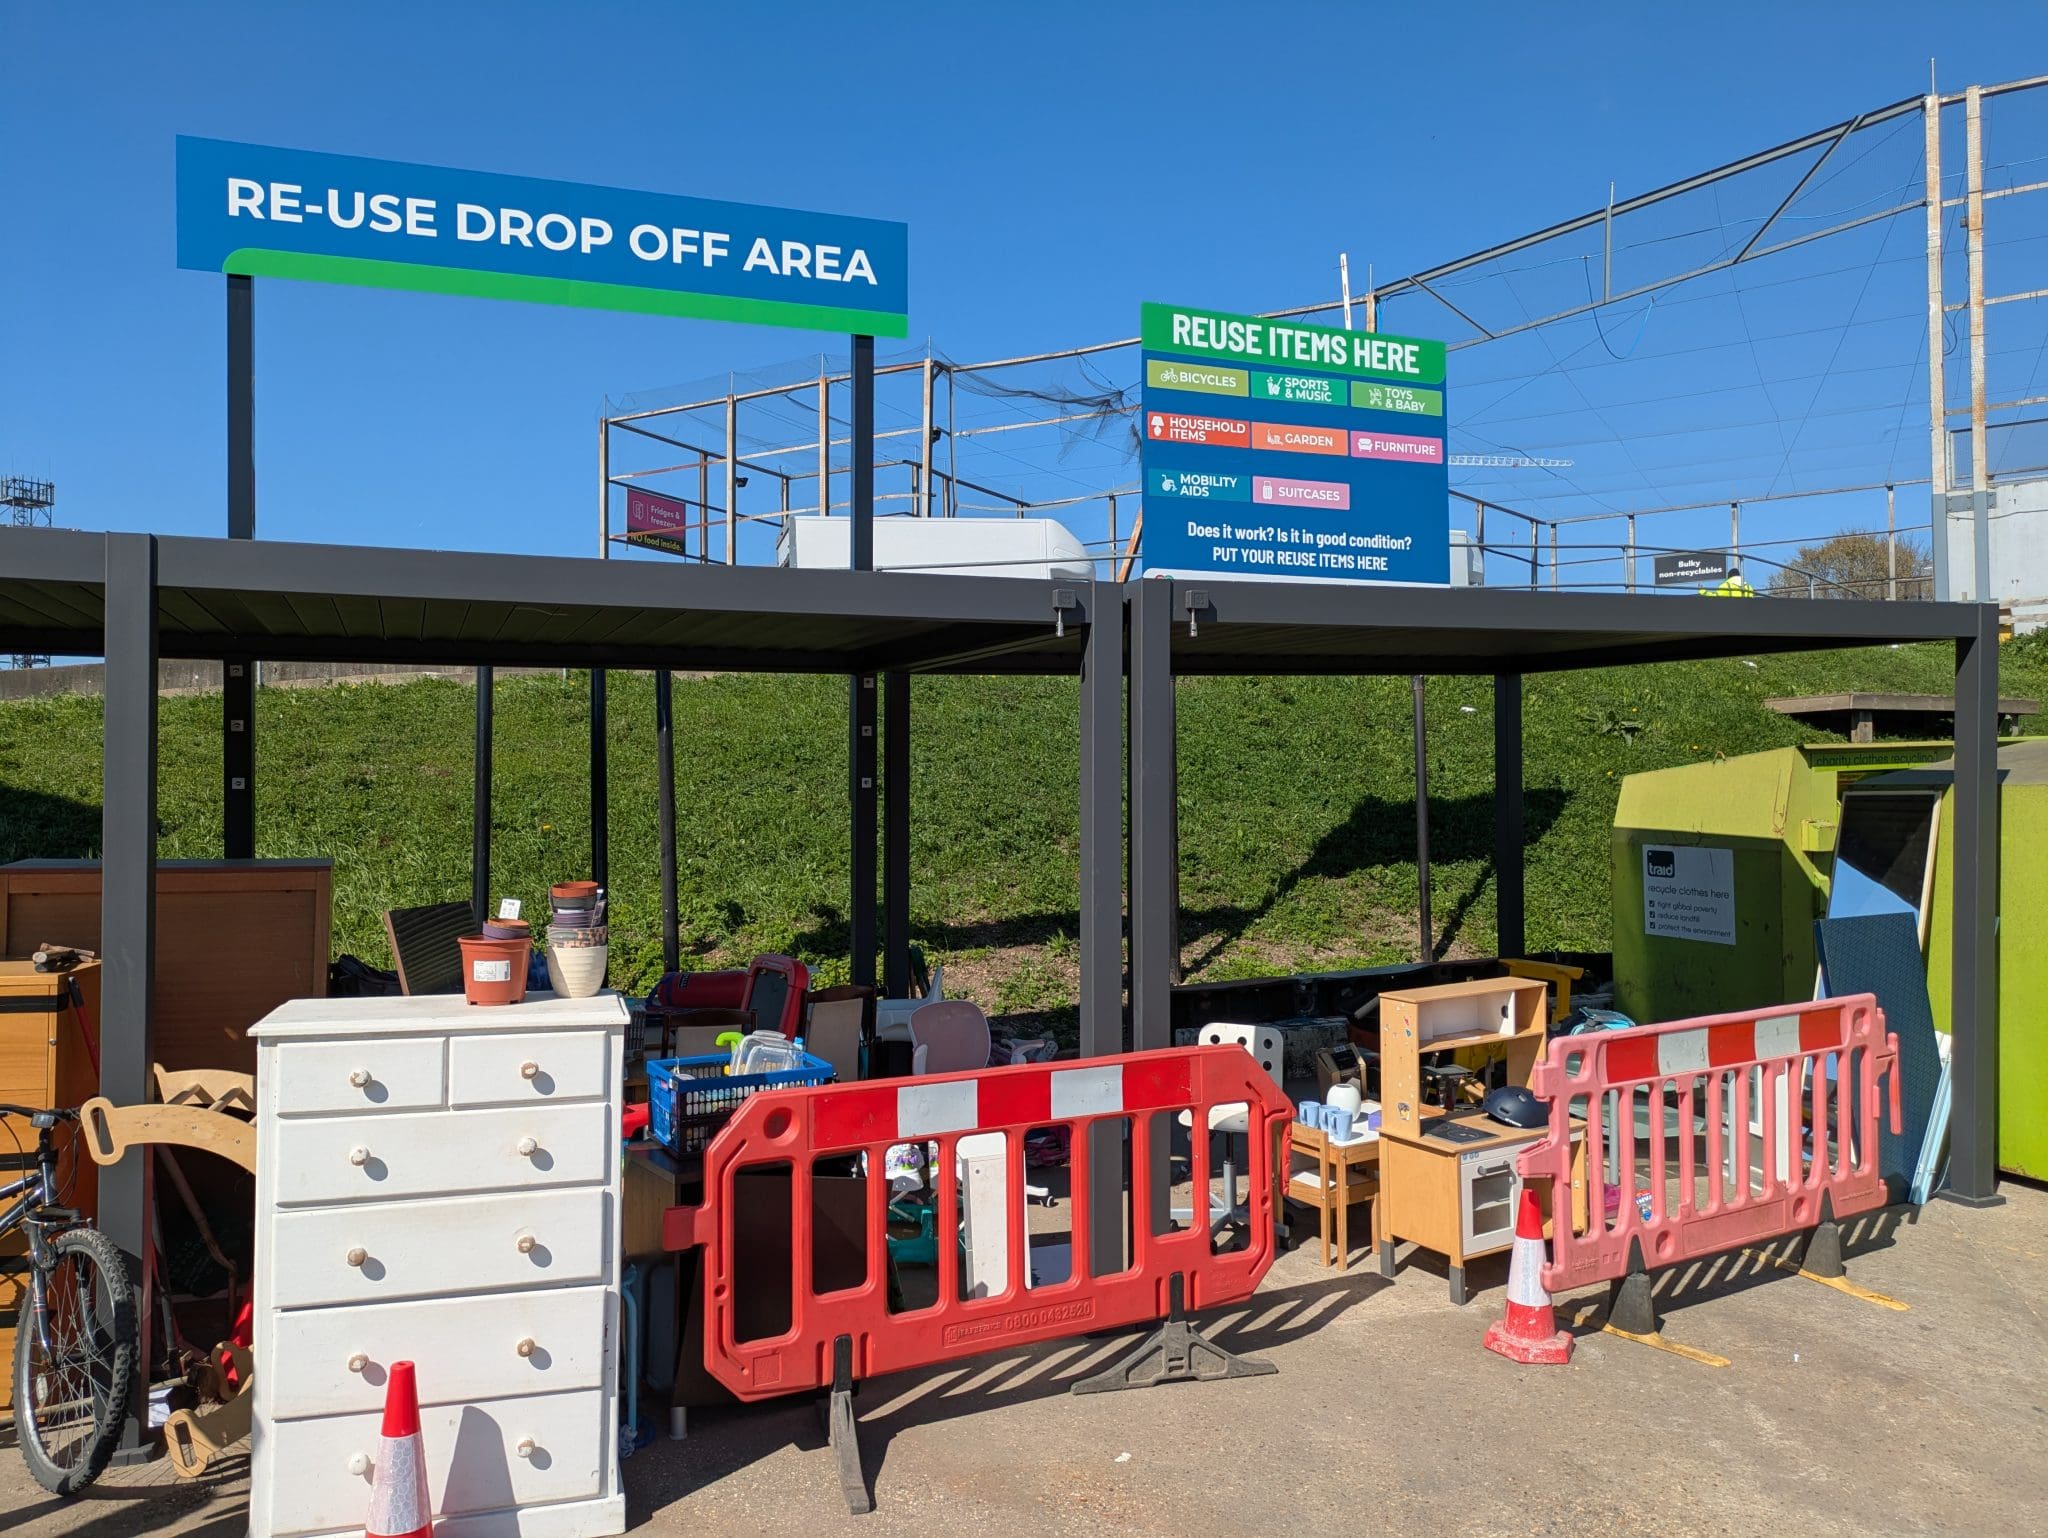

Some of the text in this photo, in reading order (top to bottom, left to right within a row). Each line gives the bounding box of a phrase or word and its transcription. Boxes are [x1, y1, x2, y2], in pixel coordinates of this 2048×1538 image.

[227, 177, 878, 286] RE-USE DROP OFF AREA
[1172, 314, 1420, 374] REUSE ITEMS HERE
[1180, 371, 1236, 388] BICYCLES
[1284, 377, 1329, 391] SPORTS
[1285, 388, 1332, 402] & MUSIC
[1385, 387, 1413, 400] TOYS
[1385, 399, 1426, 412] & BABY
[1169, 416, 1246, 434] HOUSEHOLD
[1169, 428, 1207, 442] ITEMS
[1285, 433, 1333, 447] GARDEN
[1374, 441, 1436, 456] FURNITURE
[1180, 473, 1238, 488] MOBILITY
[1180, 485, 1210, 497] AIDS
[1278, 486, 1340, 502] SUITCASES
[650, 505, 681, 520] Fridges &
[644, 535, 660, 546] food
[1187, 521, 1412, 550] Does it work? Is it in good condition?
[1213, 546, 1388, 571] PUT YOUR REUSE ITEMS HERE
[1678, 560, 1701, 568] Bulky
[1659, 566, 1722, 578] non-recyclables
[1853, 753, 1888, 765] clothes
[1649, 862, 1673, 876] traid
[1648, 885, 1730, 899] recycle clothes here
[1673, 902, 1692, 912] global
[1694, 903, 1718, 914] poverty
[1005, 1312, 1038, 1331] 0800
